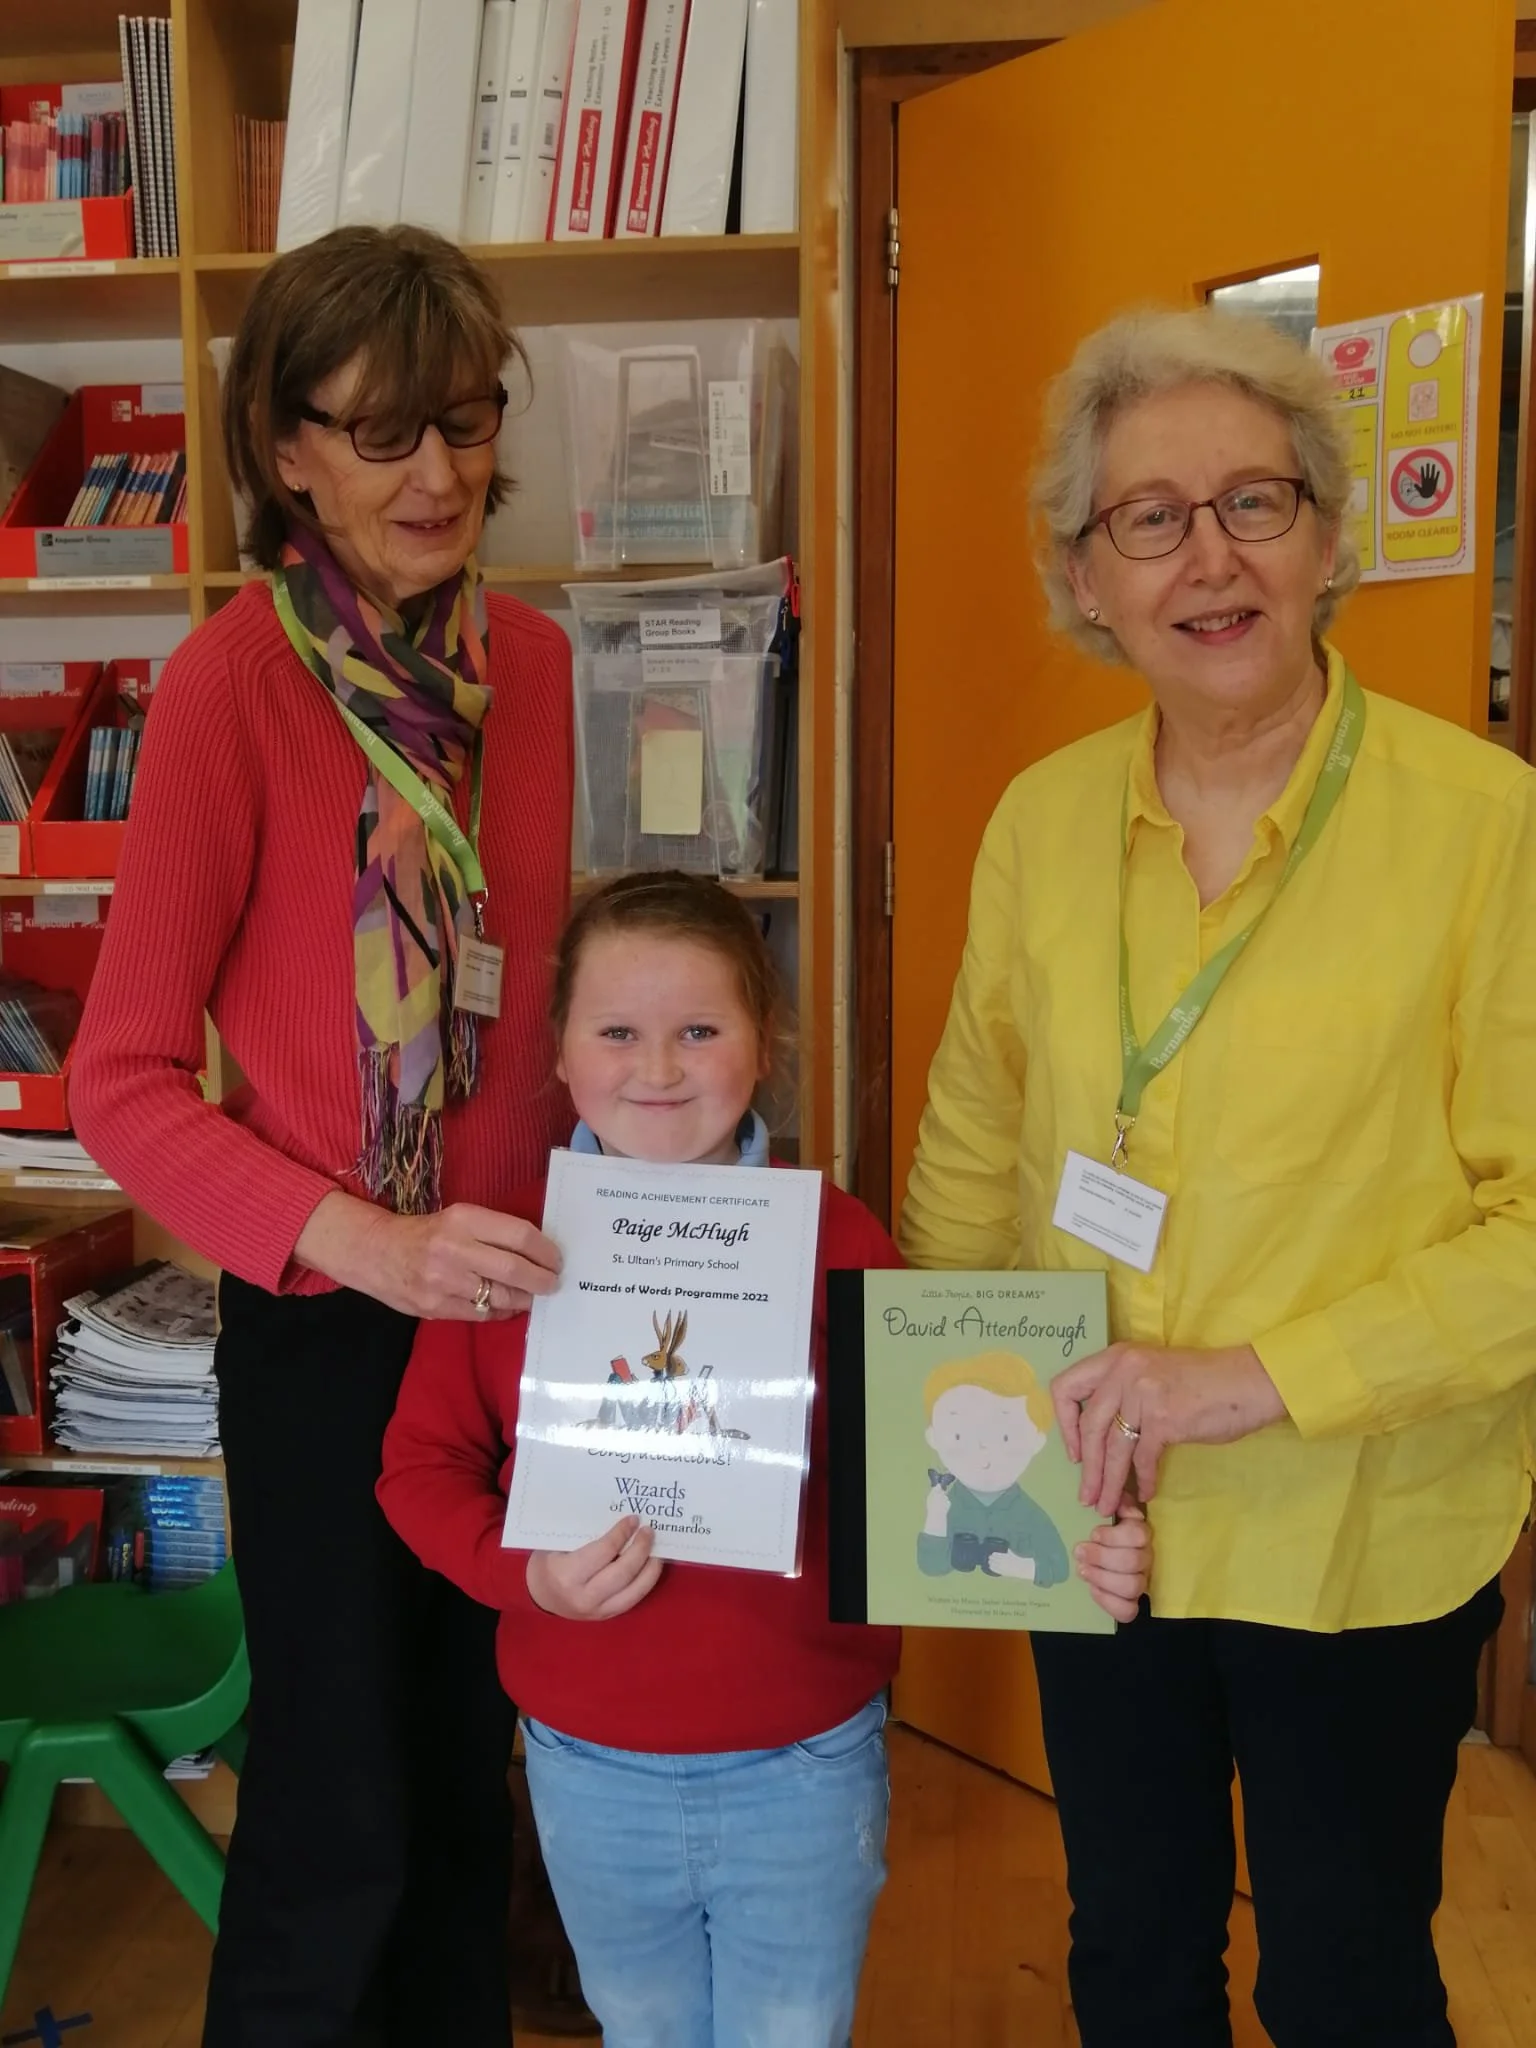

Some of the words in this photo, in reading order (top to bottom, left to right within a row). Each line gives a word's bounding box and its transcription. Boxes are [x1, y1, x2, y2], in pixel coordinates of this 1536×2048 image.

[645, 67, 657, 105] Teaching
[1386, 531, 1415, 541] ROOM
[1417, 525, 1458, 538] CLEARED
[645, 619, 667, 627] STAR
[669, 619, 701, 627] Reading
[645, 629, 670, 637] Group
[1325, 708, 1356, 772] Barnardos
[421, 789, 466, 846] Barnardos
[1150, 1004, 1200, 1069] Barnardos
[596, 1188, 639, 1200] READING
[641, 1192, 707, 1204] ACHIEVEMENT
[709, 1196, 770, 1208] CERTIFICATE
[612, 1218, 662, 1242] Paige
[667, 1221, 751, 1247] McHugh
[612, 1254, 624, 1264] St.
[627, 1255, 661, 1266] Ultan's
[664, 1257, 704, 1269] Primary
[707, 1259, 739, 1270] School
[579, 1281, 622, 1293] Wizards
[625, 1284, 636, 1294] of
[638, 1285, 672, 1296] Words
[674, 1287, 739, 1300] Programme
[742, 1292, 769, 1302] 2022
[976, 1290, 994, 1299] BIG
[883, 1306, 947, 1337] David
[954, 1305, 1087, 1357] Attenborough
[614, 1477, 686, 1500] Wizards
[609, 1499, 626, 1512] of
[627, 1497, 684, 1518] Words
[649, 1519, 711, 1535] Barnardos
